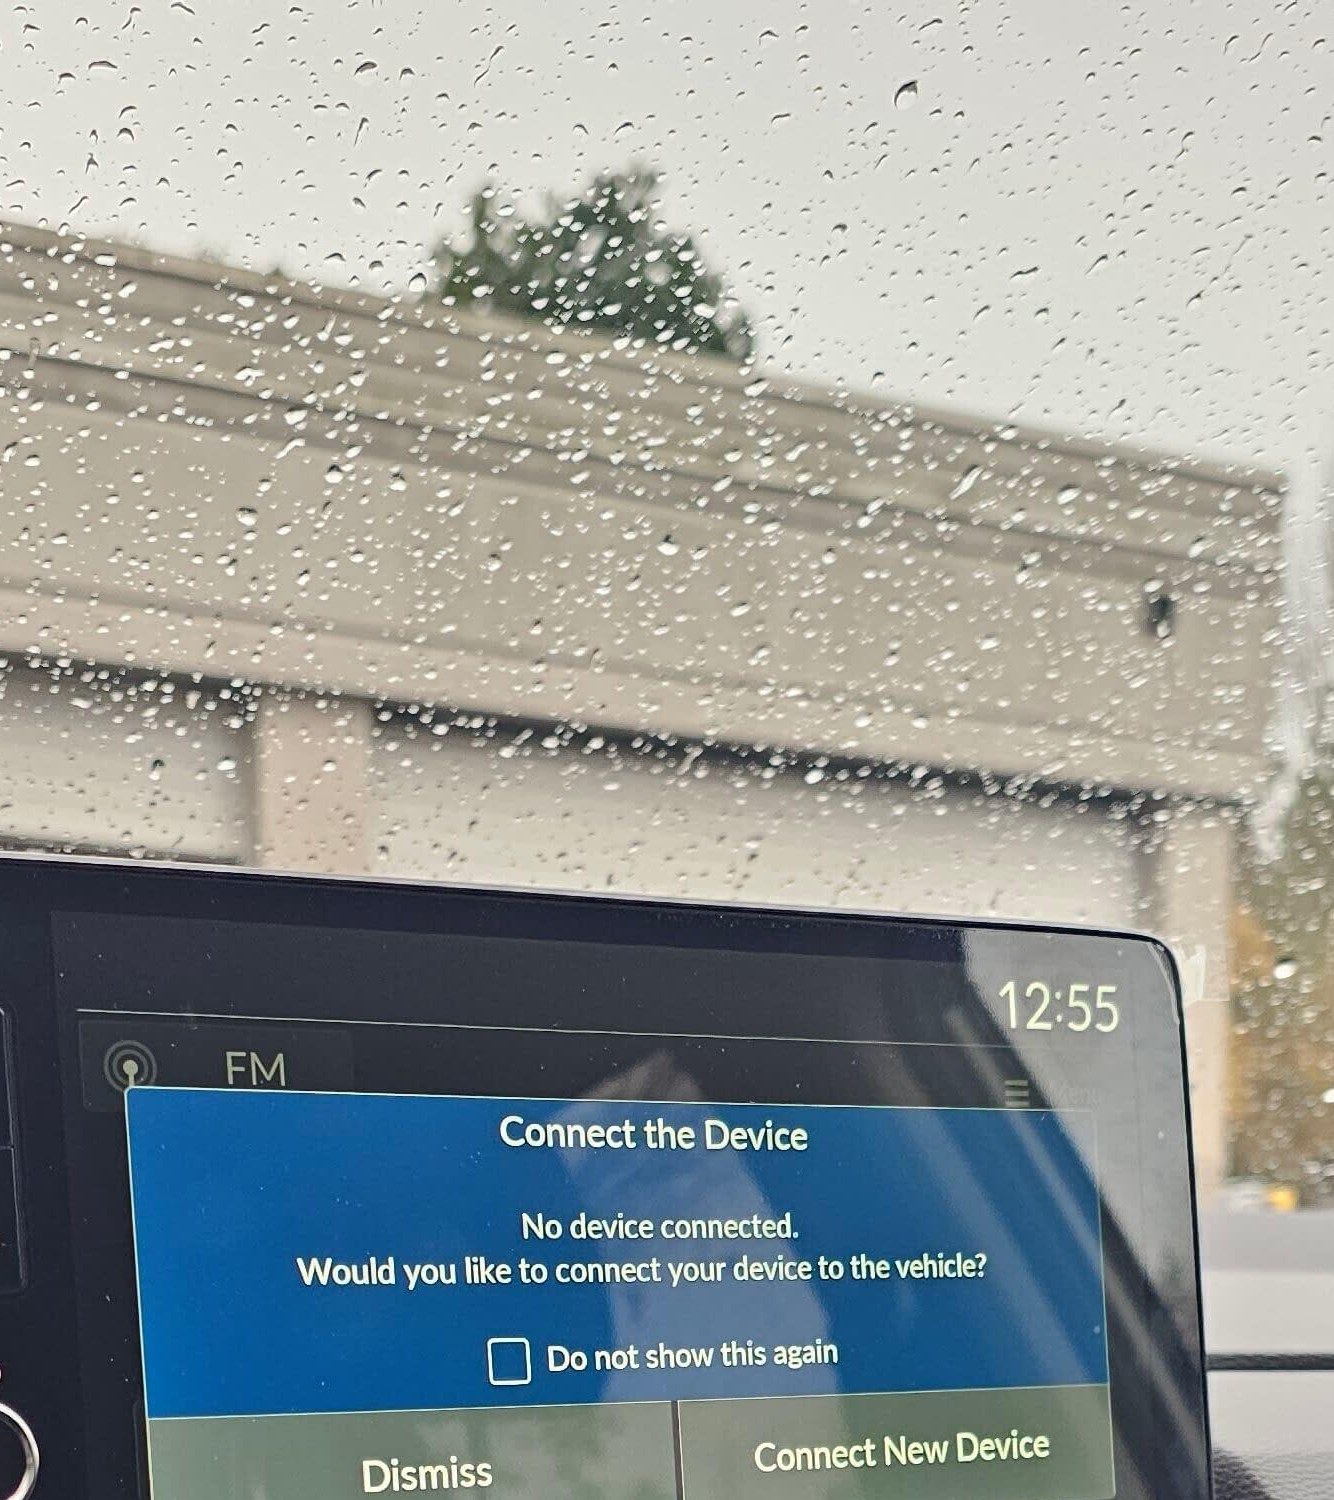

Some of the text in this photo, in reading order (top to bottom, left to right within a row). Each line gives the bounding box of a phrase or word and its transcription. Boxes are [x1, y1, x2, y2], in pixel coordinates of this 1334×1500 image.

[998, 980, 1120, 1033] 12:55
[227, 1052, 286, 1087] FM
[499, 1115, 808, 1151] Connect the Device
[521, 1212, 799, 1240] No device connected.
[296, 1252, 987, 1291] Would you like to connect your device to the vehicle?
[547, 1339, 839, 1372] Do not show this again
[754, 1428, 1050, 1473] Connect New Device
[362, 1455, 493, 1494] Dismiss
